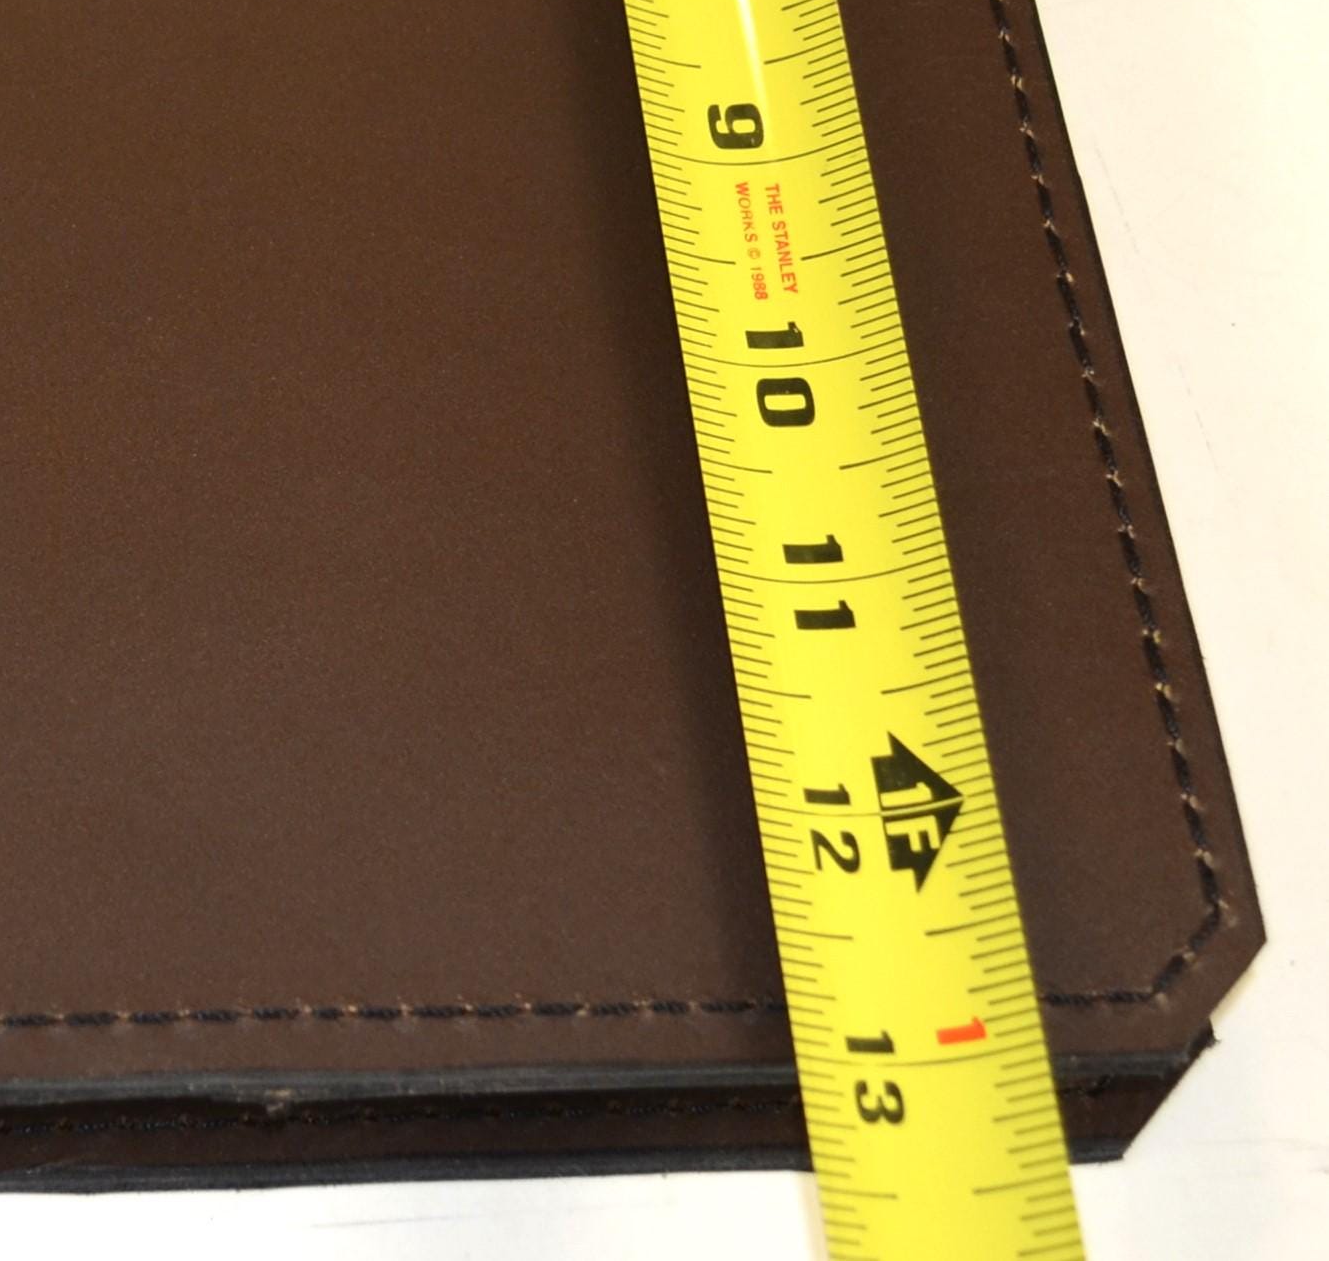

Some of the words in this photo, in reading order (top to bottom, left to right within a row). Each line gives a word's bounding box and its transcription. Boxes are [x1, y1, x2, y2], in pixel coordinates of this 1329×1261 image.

[707, 103, 764, 150] 9
[735, 181, 758, 243] WORKS
[750, 266, 768, 300] 1988
[765, 183, 783, 215] THE
[772, 221, 798, 294] STANLEY
[745, 321, 815, 427] 10
[782, 534, 856, 630] 11
[803, 783, 860, 874] 12
[936, 1016, 986, 1045] 1
[845, 1029, 905, 1126] 13
